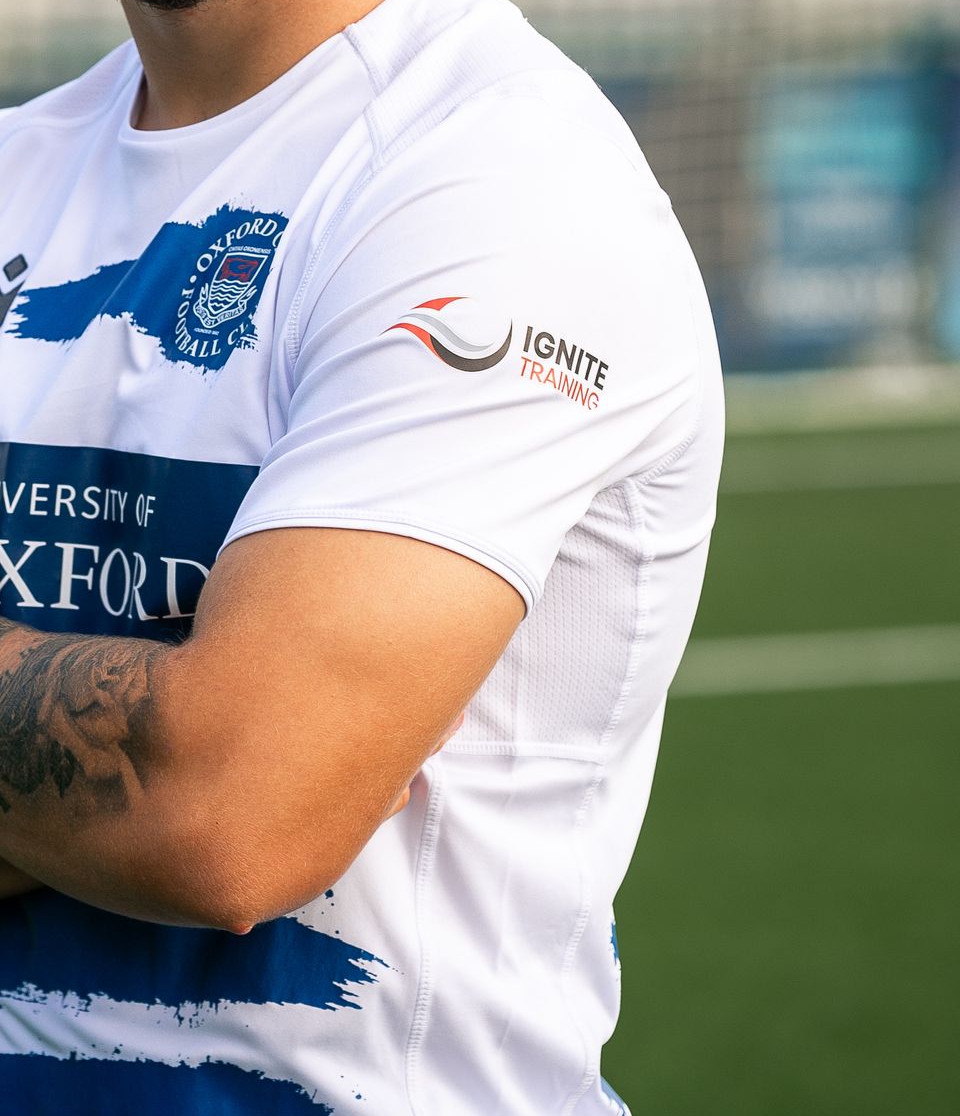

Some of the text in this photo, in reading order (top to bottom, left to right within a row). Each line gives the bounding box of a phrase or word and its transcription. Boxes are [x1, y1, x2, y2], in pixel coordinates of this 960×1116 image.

[196, 217, 278, 273] OXFORD
[174, 288, 222, 358] FOOTBALL
[520, 355, 600, 410] TRAINING
[523, 325, 609, 391] IGNITE
[135, 493, 156, 527] OF
